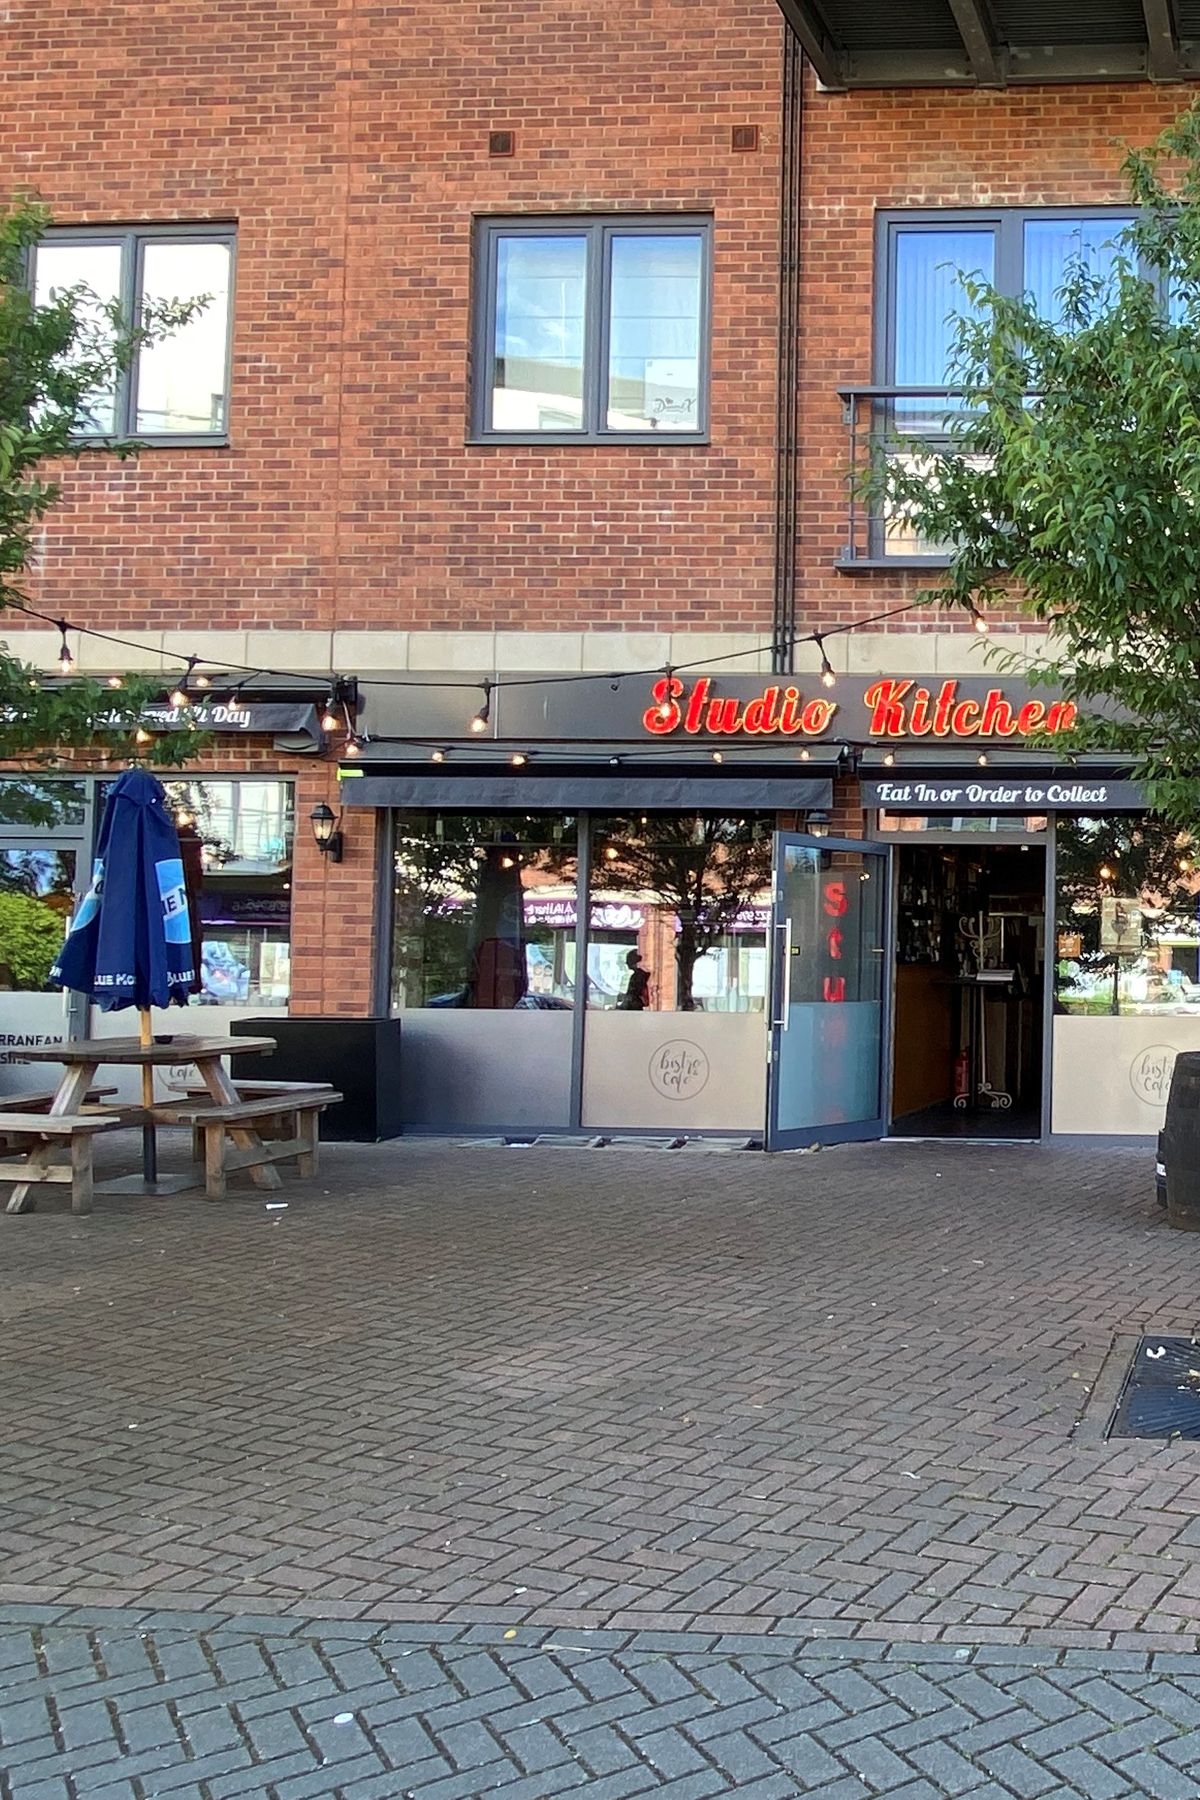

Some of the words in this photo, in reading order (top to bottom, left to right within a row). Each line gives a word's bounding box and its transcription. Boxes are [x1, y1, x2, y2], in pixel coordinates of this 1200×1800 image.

[211, 705, 251, 729] Day
[643, 677, 837, 736] Studio
[864, 679, 1078, 737] Kitchen
[876, 783, 912, 802] Eat
[914, 783, 938, 802] In
[939, 786, 962, 801] or
[964, 784, 1022, 803] Order
[1024, 785, 1046, 801] to
[1046, 784, 1108, 803] Collect
[93, 973, 114, 985] LUE
